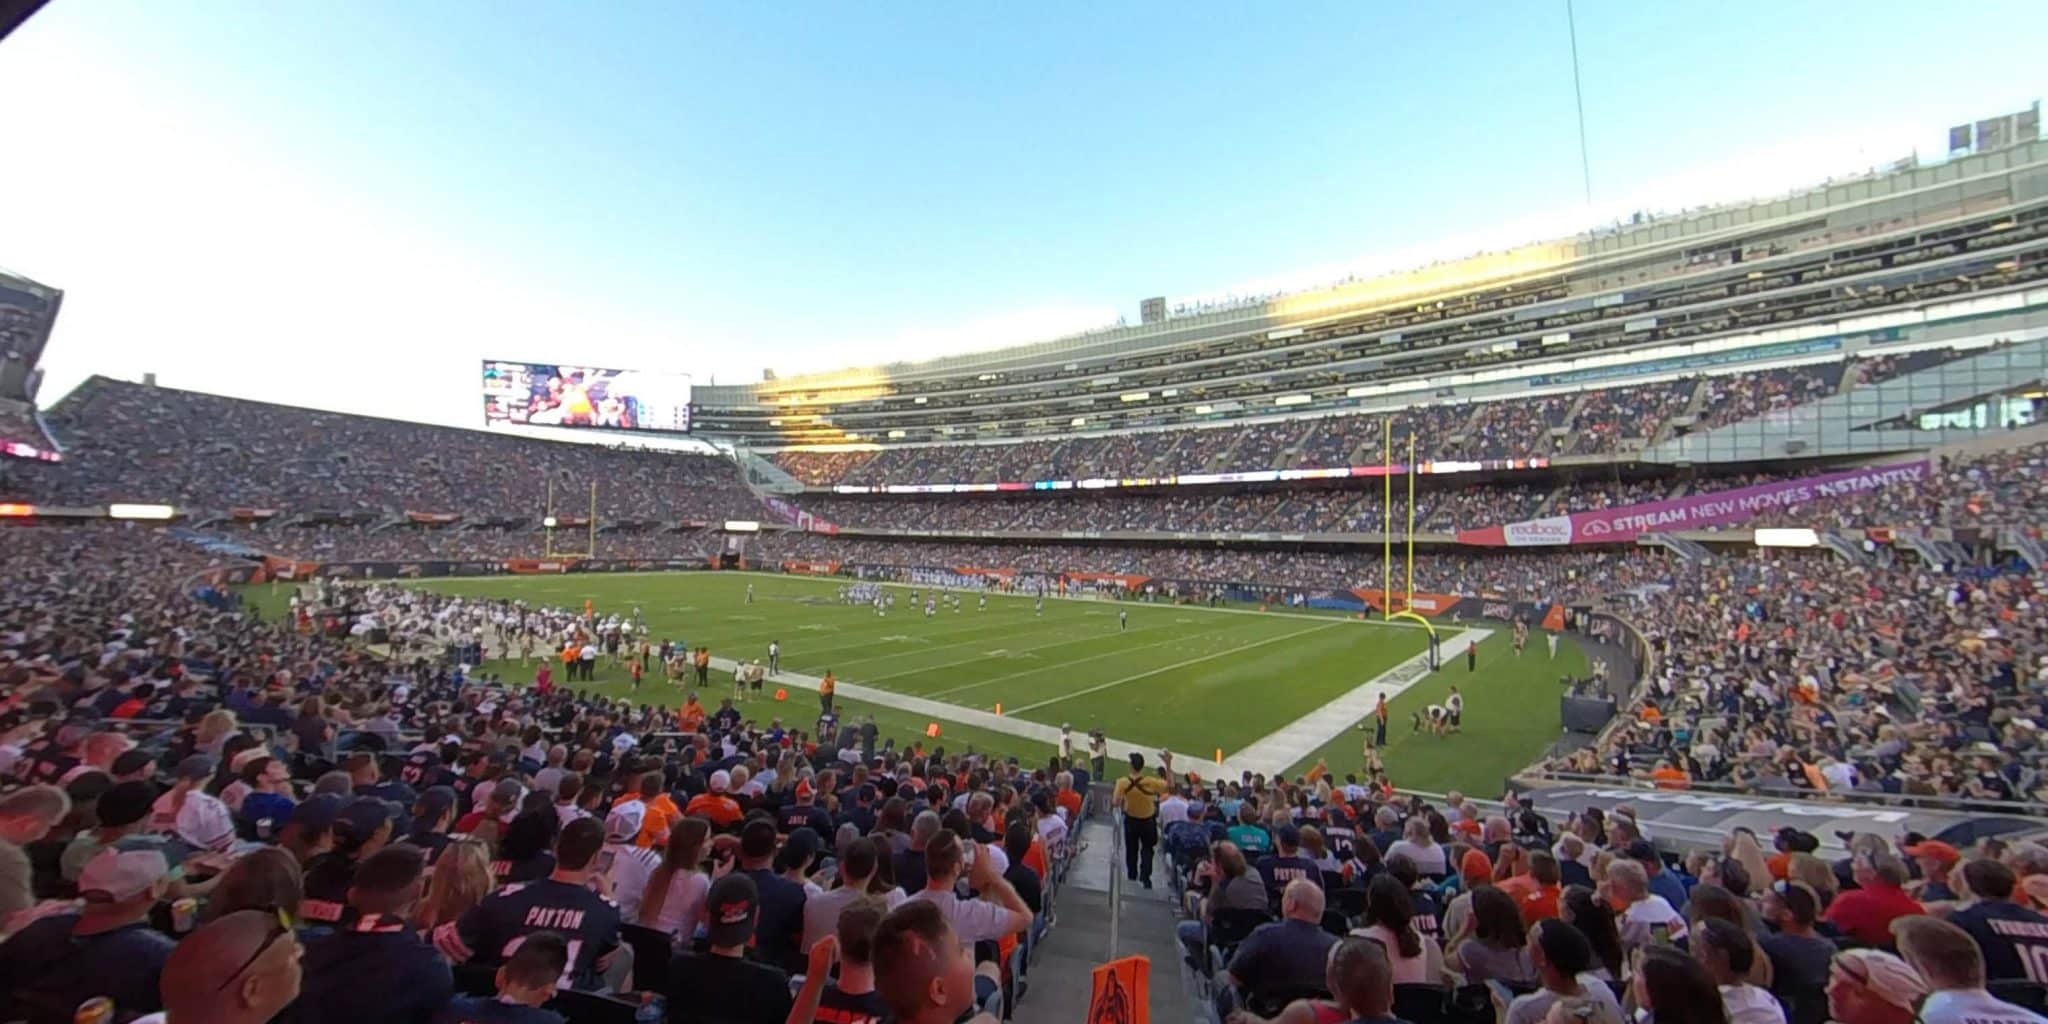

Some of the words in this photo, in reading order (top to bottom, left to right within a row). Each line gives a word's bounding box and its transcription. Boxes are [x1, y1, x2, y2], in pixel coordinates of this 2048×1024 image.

[1613, 509, 1687, 531] STREAM
[1692, 499, 1736, 519] NEW
[524, 906, 585, 929] PAYTON
